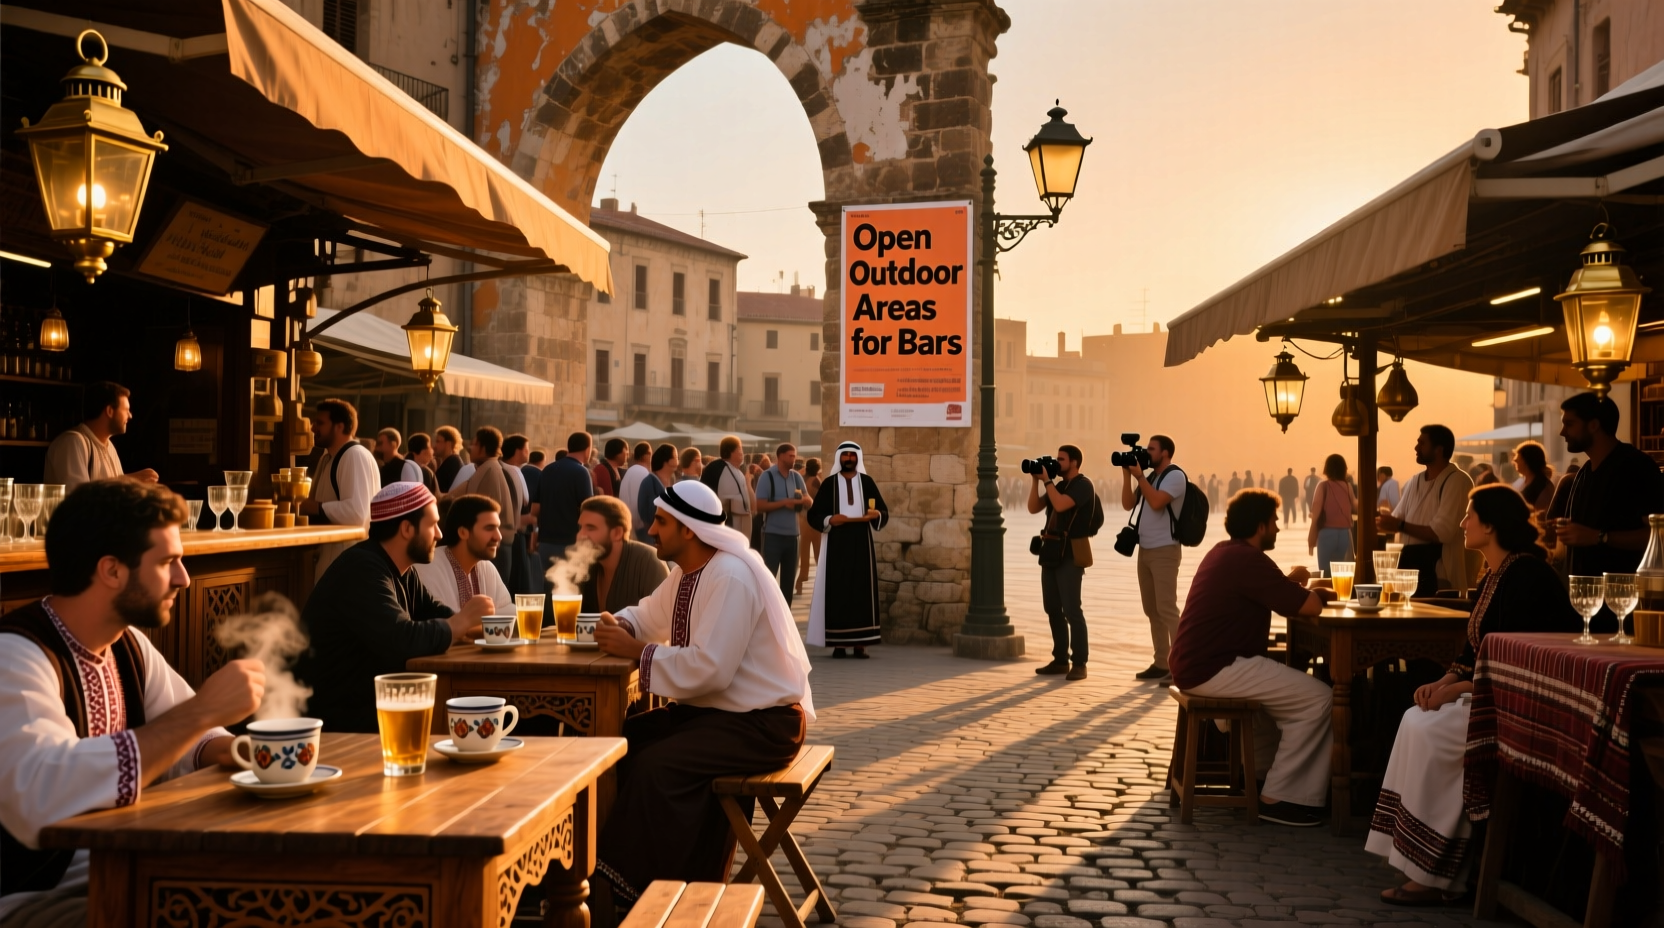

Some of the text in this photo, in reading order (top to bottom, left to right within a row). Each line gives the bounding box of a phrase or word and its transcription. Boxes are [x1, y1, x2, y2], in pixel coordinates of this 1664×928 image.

[853, 223, 931, 258] Open
[849, 257, 963, 286] Outdoor
[852, 293, 937, 321] Areas
[851, 327, 962, 356] for Bars
